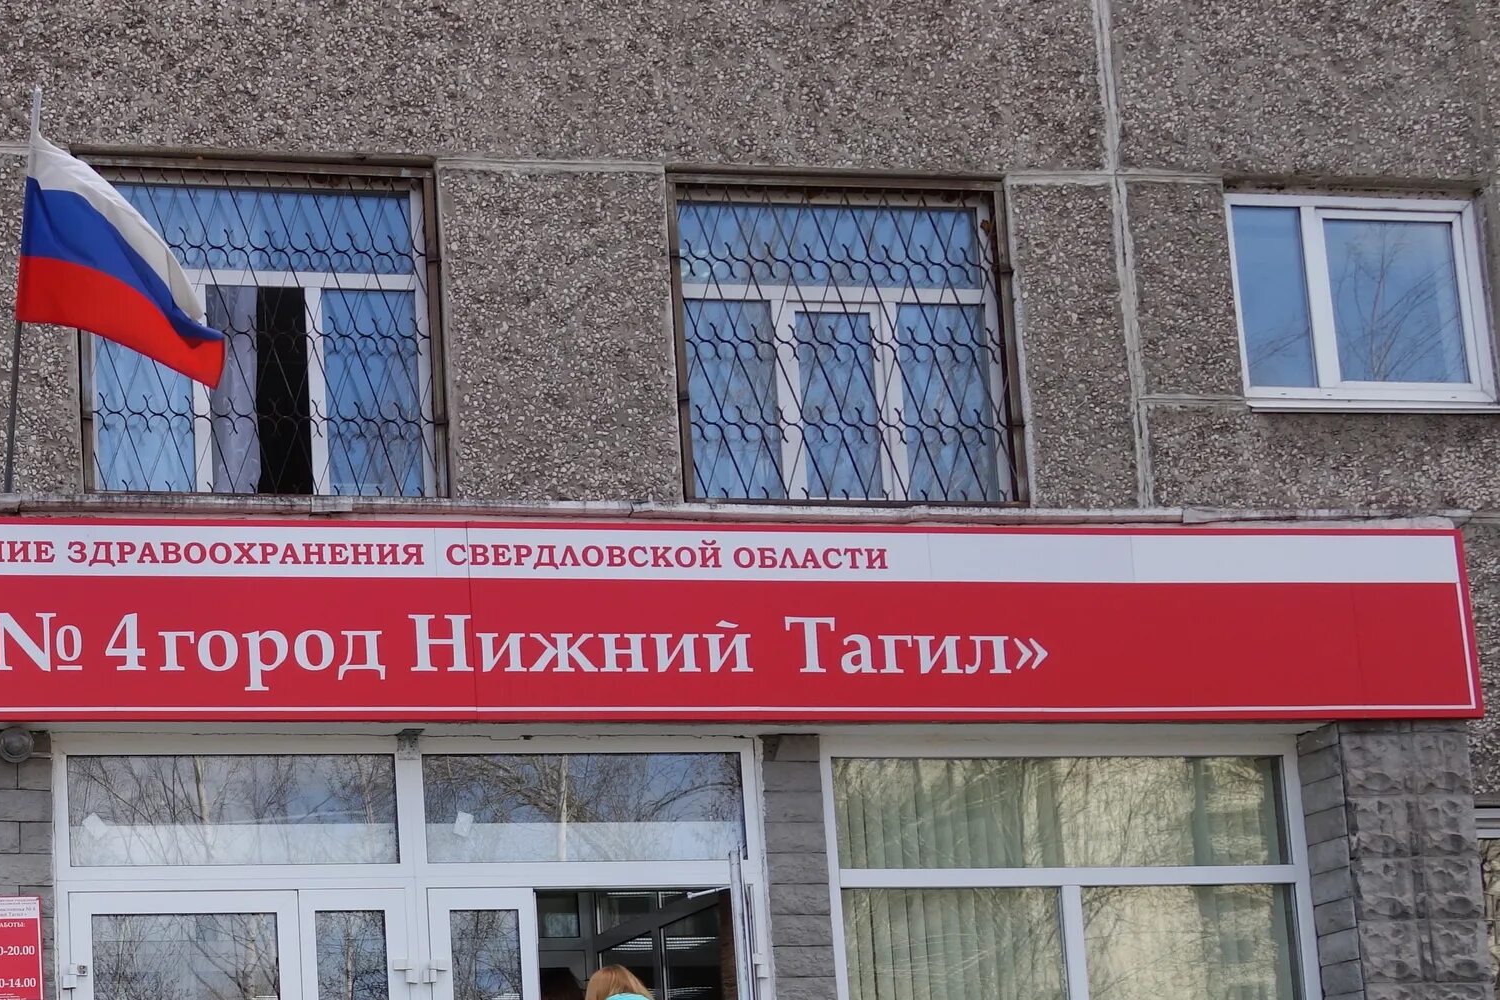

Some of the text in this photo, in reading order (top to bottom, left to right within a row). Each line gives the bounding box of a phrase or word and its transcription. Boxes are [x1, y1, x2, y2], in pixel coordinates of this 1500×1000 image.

[68, 540, 424, 567] ЗДРАВООХРАНЕНИЯ
[446, 540, 721, 570] СВЕРДЛОВСКОЙ
[733, 546, 888, 570] ОБЛАСТИ
[408, 613, 754, 673] Нижний
[784, 615, 1049, 675] Тагил»
